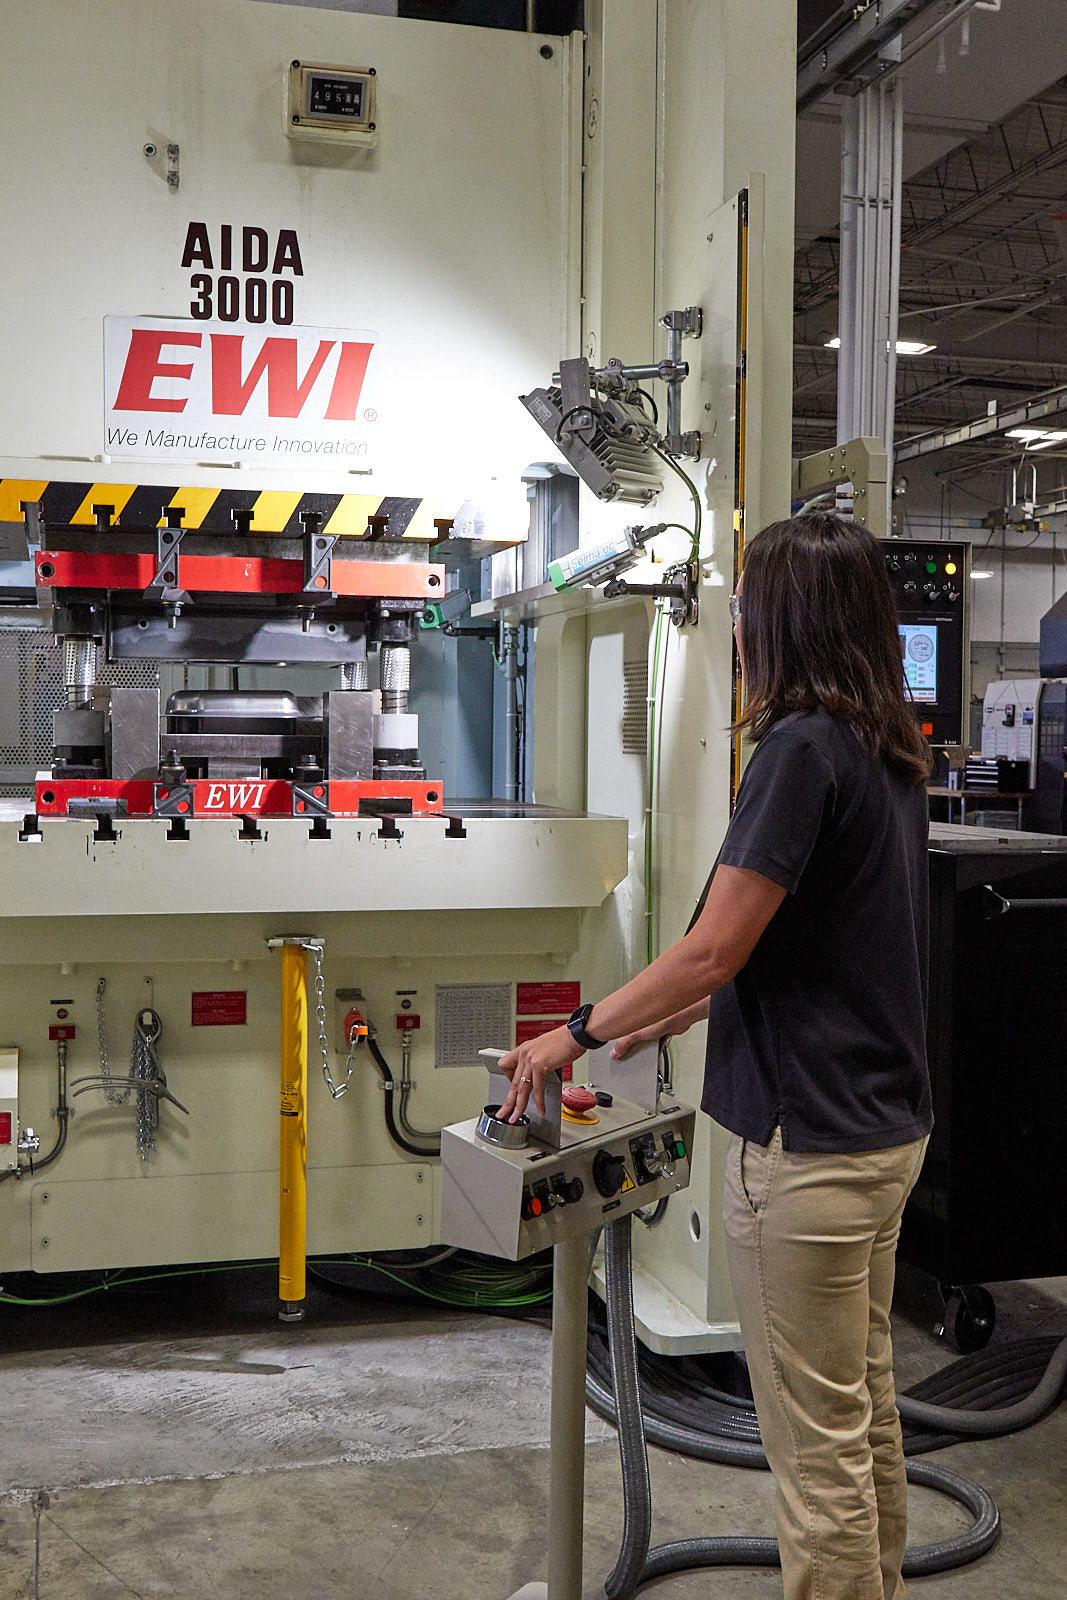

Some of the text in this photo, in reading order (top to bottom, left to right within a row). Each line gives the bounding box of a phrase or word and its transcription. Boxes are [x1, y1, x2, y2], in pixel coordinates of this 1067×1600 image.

[181, 221, 304, 276] AIDA
[190, 273, 294, 325] 3000
[112, 329, 375, 421] EWI
[107, 428, 368, 455] We Manufacture Innovation
[203, 783, 267, 809] EWI
